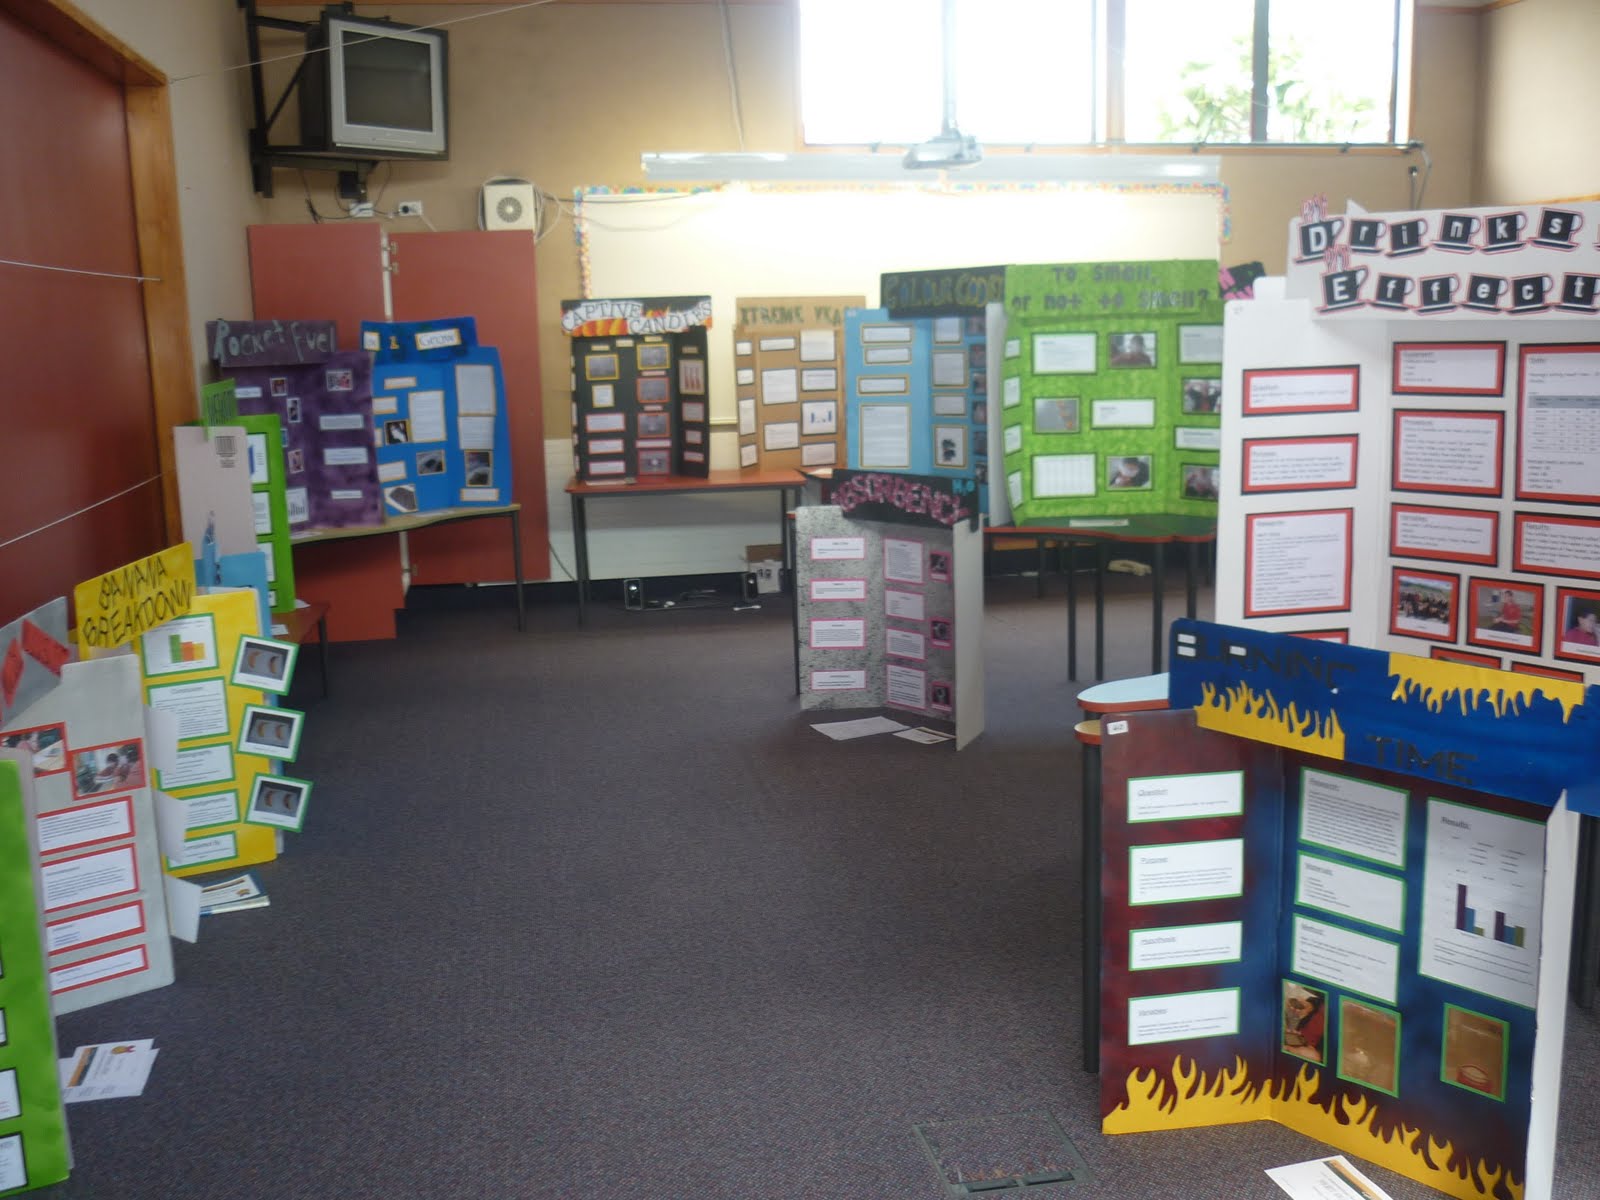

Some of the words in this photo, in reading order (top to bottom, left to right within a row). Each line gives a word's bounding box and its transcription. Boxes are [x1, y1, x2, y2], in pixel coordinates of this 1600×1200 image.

[1307, 216, 1564, 254] Drinks
[1331, 275, 1586, 302] Effect
[561, 301, 643, 332] CAPTIVE
[213, 317, 286, 366] Rocket
[290, 321, 336, 363] Fuel
[98, 554, 168, 611] BANANA
[82, 578, 193, 649] BREAKDOWN
[1366, 731, 1476, 787] TIME
